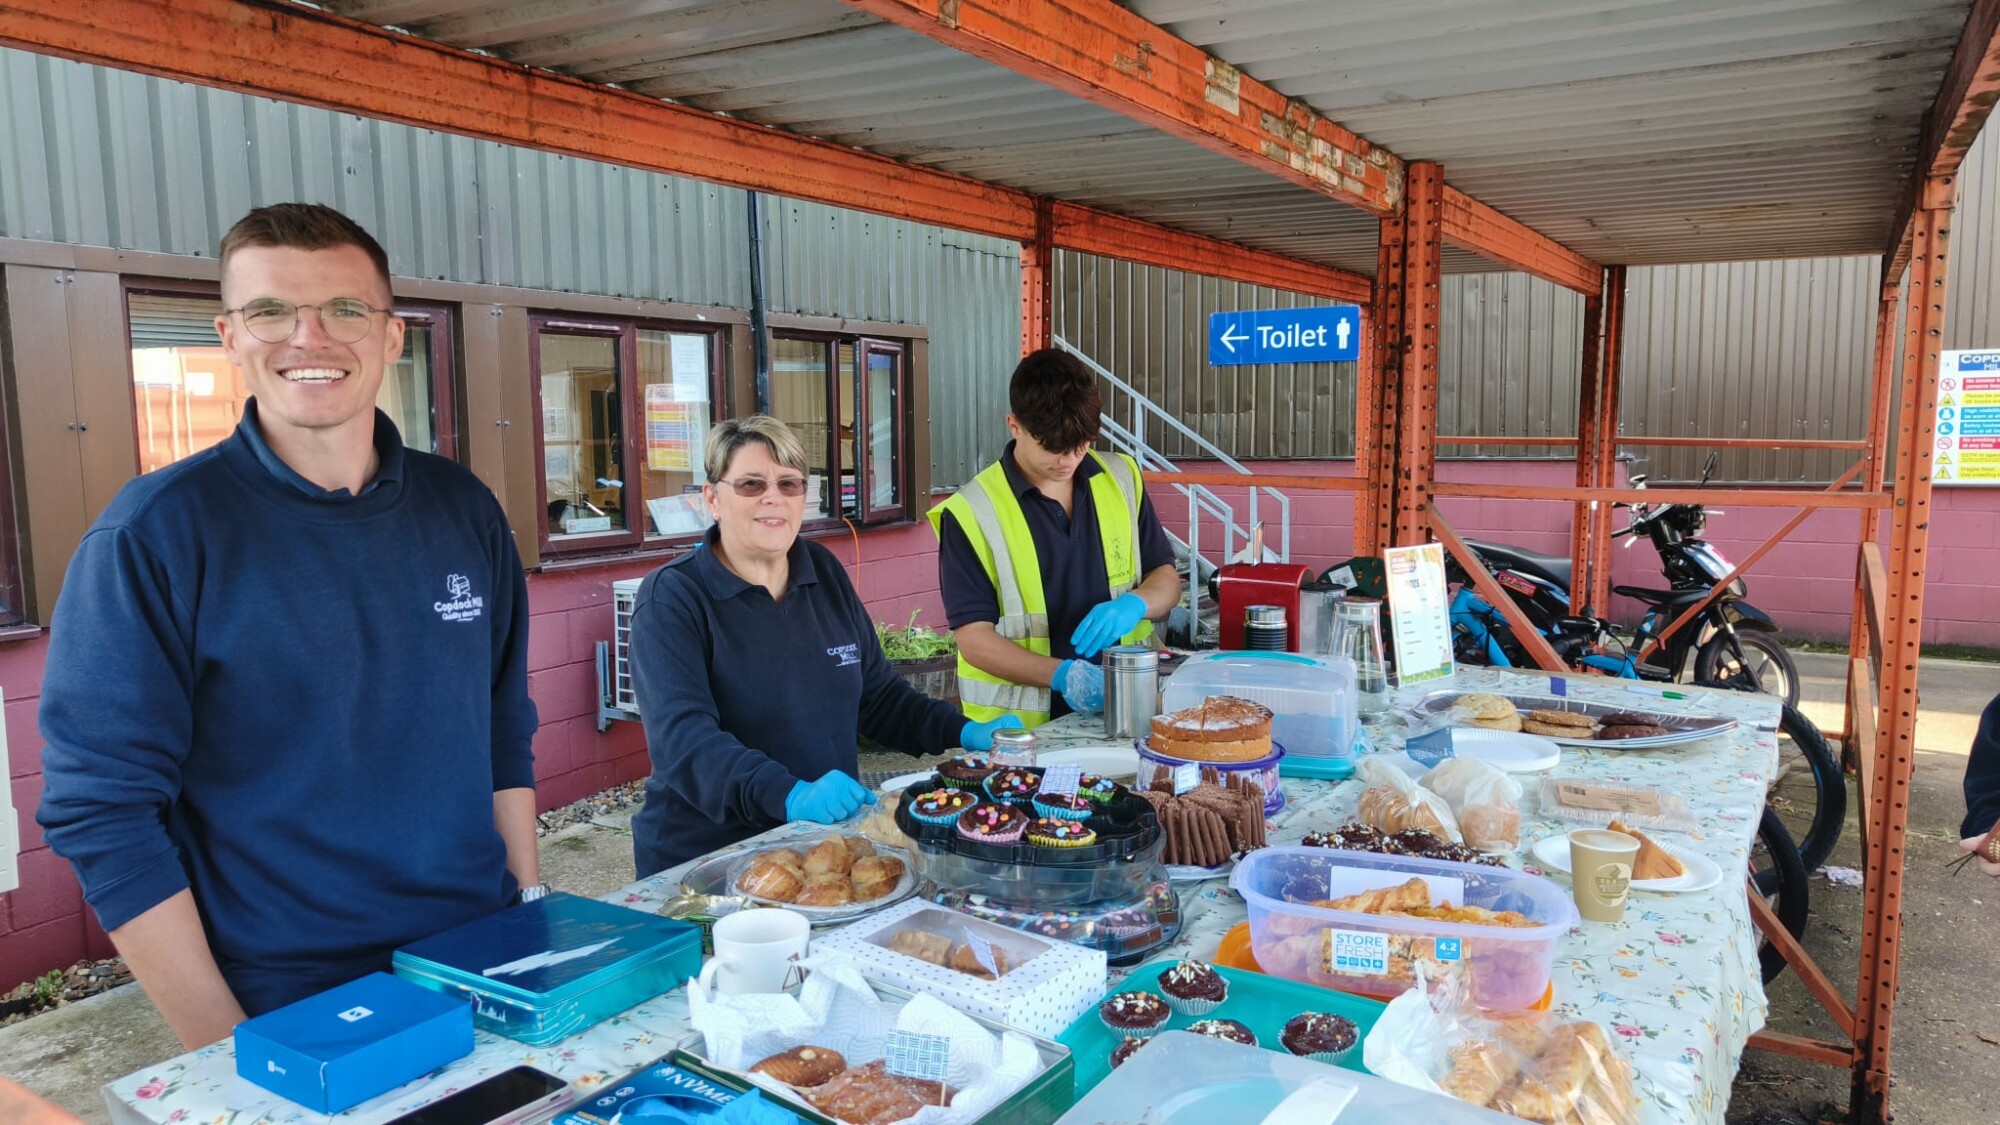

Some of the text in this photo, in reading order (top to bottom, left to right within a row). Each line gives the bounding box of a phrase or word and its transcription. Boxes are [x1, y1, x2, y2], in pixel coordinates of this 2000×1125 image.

[1257, 323, 1328, 349] Toilet
[1336, 933, 1384, 947] STORE
[1439, 942, 1457, 952] 4.2
[1335, 945, 1384, 959] FRESH
